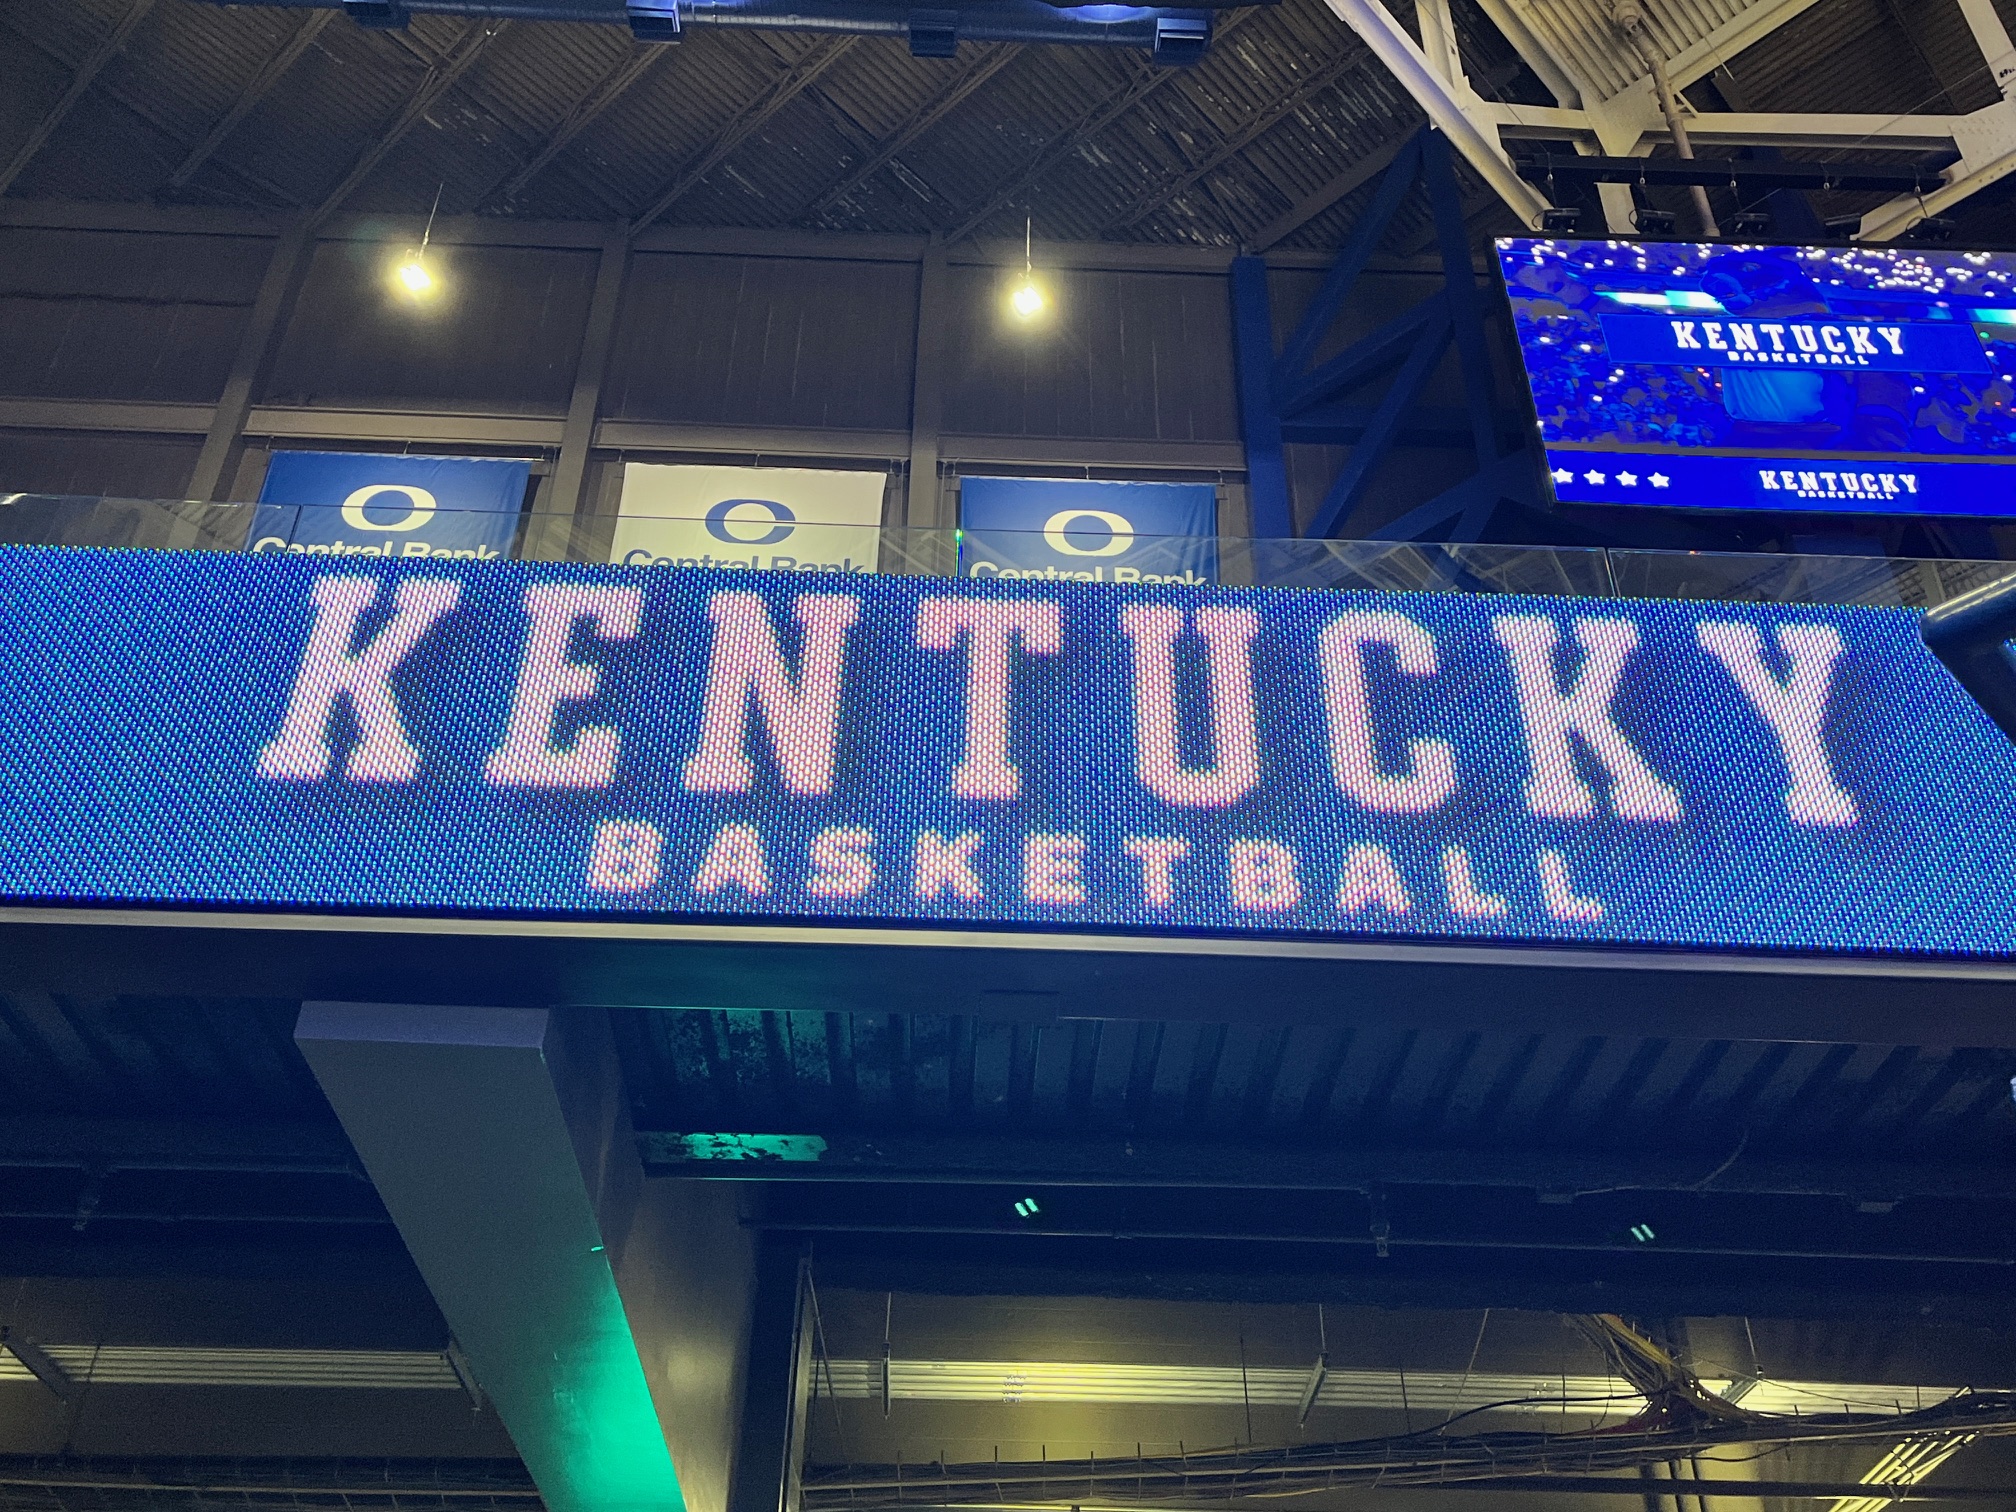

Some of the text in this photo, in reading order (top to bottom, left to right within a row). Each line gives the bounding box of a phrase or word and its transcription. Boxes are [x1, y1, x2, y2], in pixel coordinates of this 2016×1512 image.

[1671, 321, 1904, 354] KENTUCKY
[1727, 351, 1869, 365] BASKETBALL
[1759, 470, 1917, 493] KENTUCKY
[255, 573, 1859, 829] KENTUCKY
[586, 818, 1606, 921] BASKETBALL
